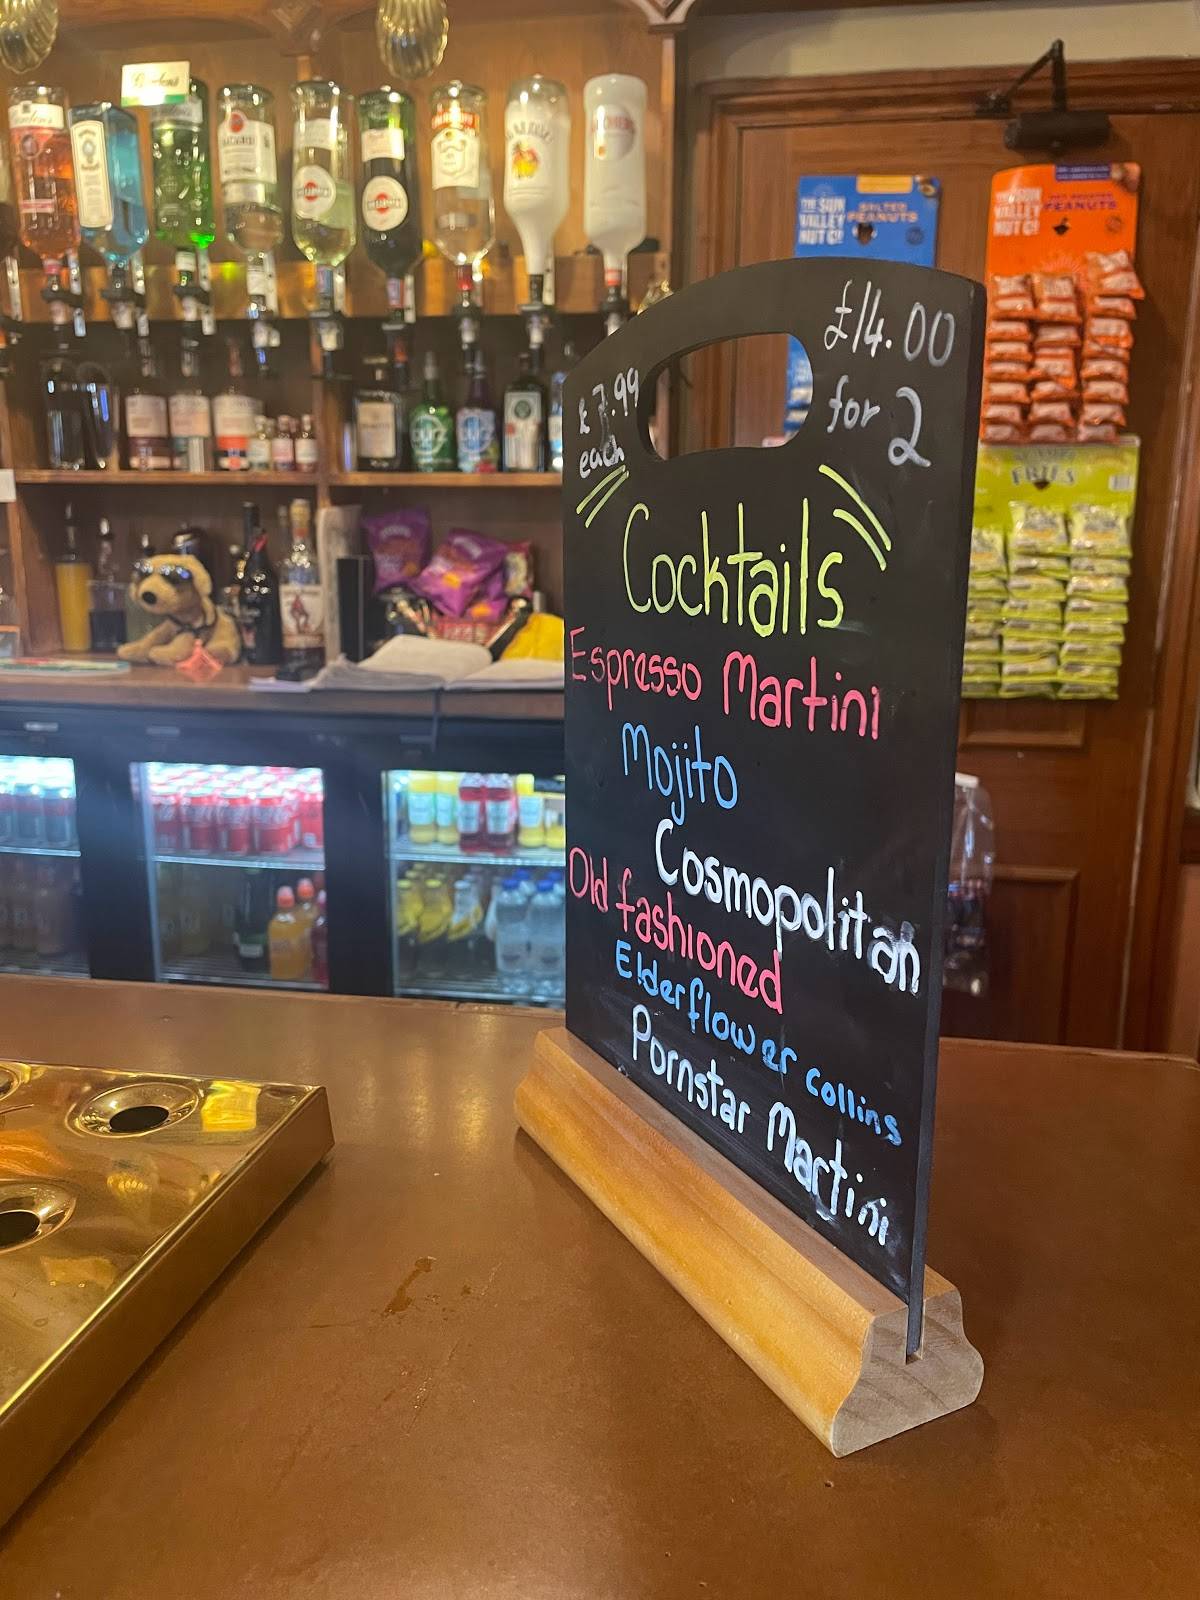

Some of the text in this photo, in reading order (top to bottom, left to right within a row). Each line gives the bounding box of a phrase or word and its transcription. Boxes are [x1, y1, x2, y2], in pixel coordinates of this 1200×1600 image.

[799, 213, 846, 229] VALLEY
[799, 230, 825, 245] NUT
[847, 211, 919, 223] PEANUTS
[823, 279, 956, 367] £14.00
[579, 434, 625, 479] each
[827, 375, 931, 468] for 2
[623, 497, 844, 638] Cocktails
[569, 626, 881, 740] Espresso Martini
[621, 722, 738, 826] Mojito
[569, 846, 783, 1015] Old fashioned
[655, 818, 921, 996] Cosmopolitan
[615, 938, 798, 1075] Elderflower
[632, 1003, 890, 1246] Pornstar Martini
